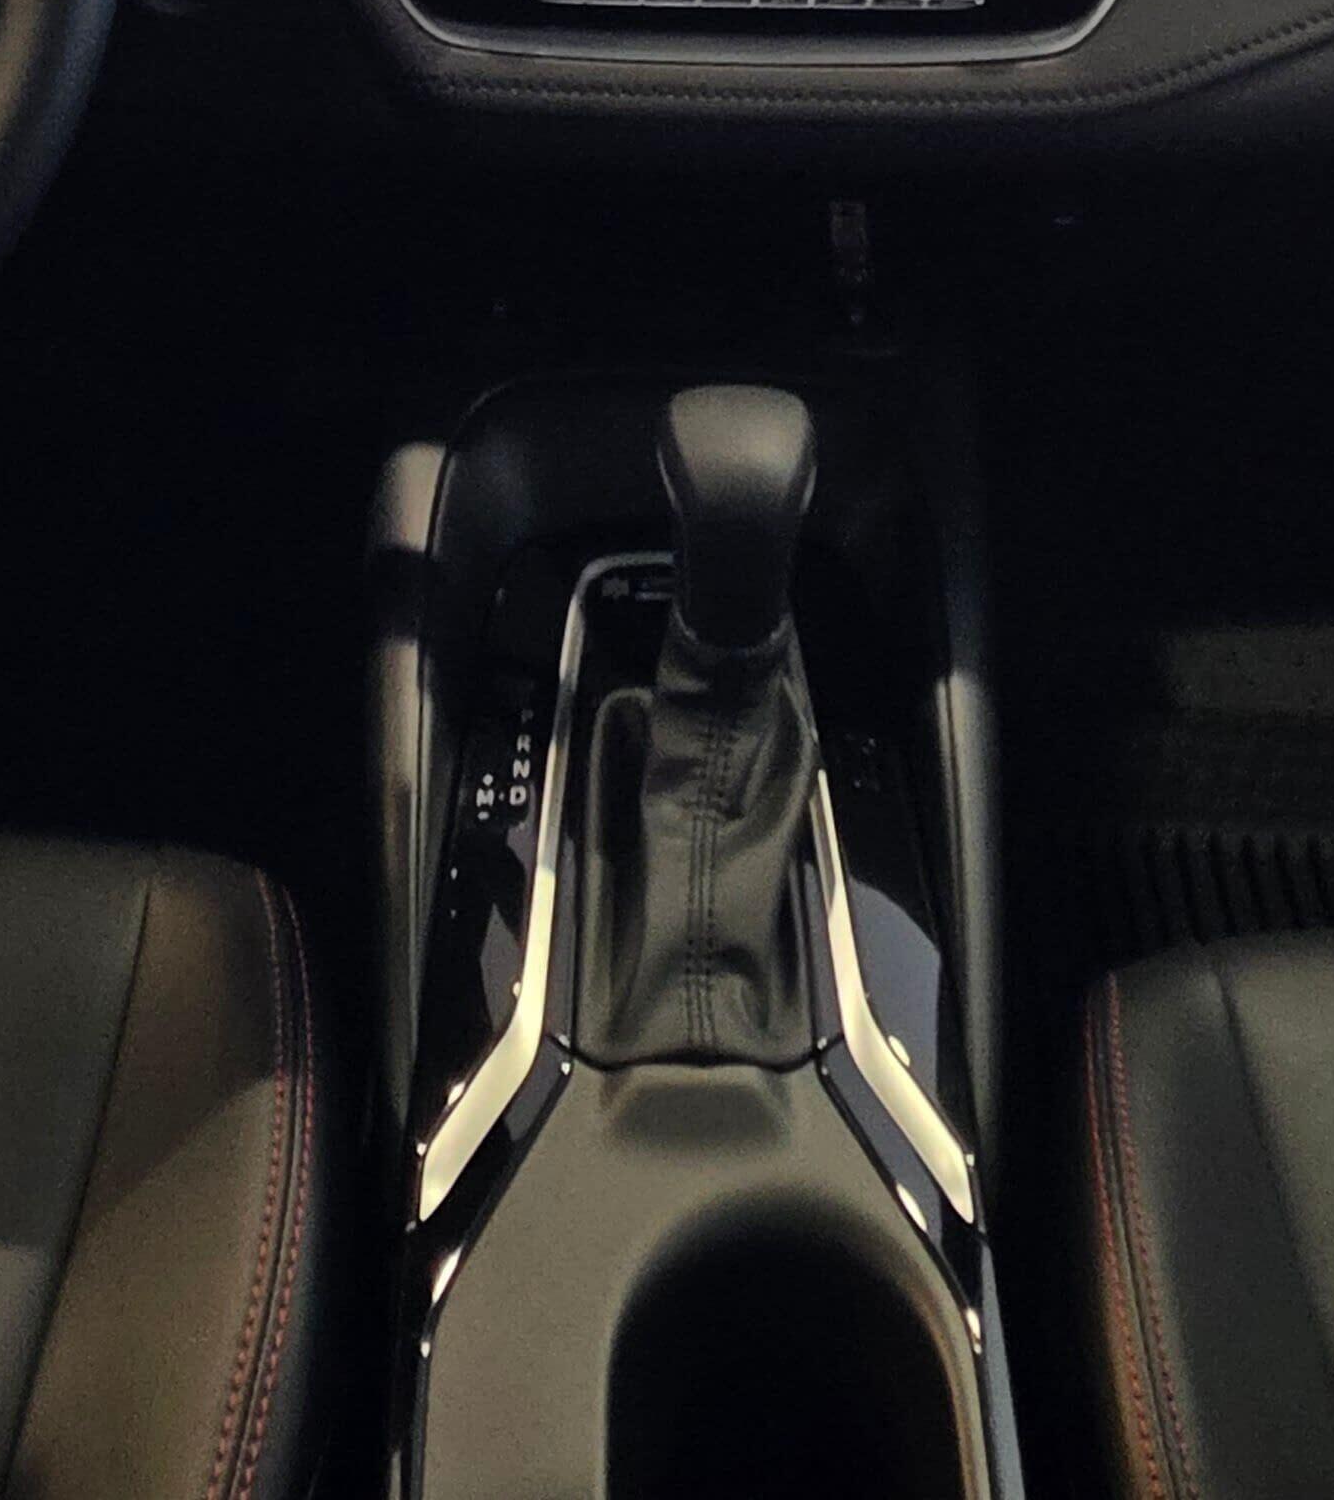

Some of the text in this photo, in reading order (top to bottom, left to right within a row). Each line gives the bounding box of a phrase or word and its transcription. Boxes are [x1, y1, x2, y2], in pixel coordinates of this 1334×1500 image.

[516, 733, 531, 752] R
[513, 759, 530, 779] N
[476, 785, 527, 808] M D
